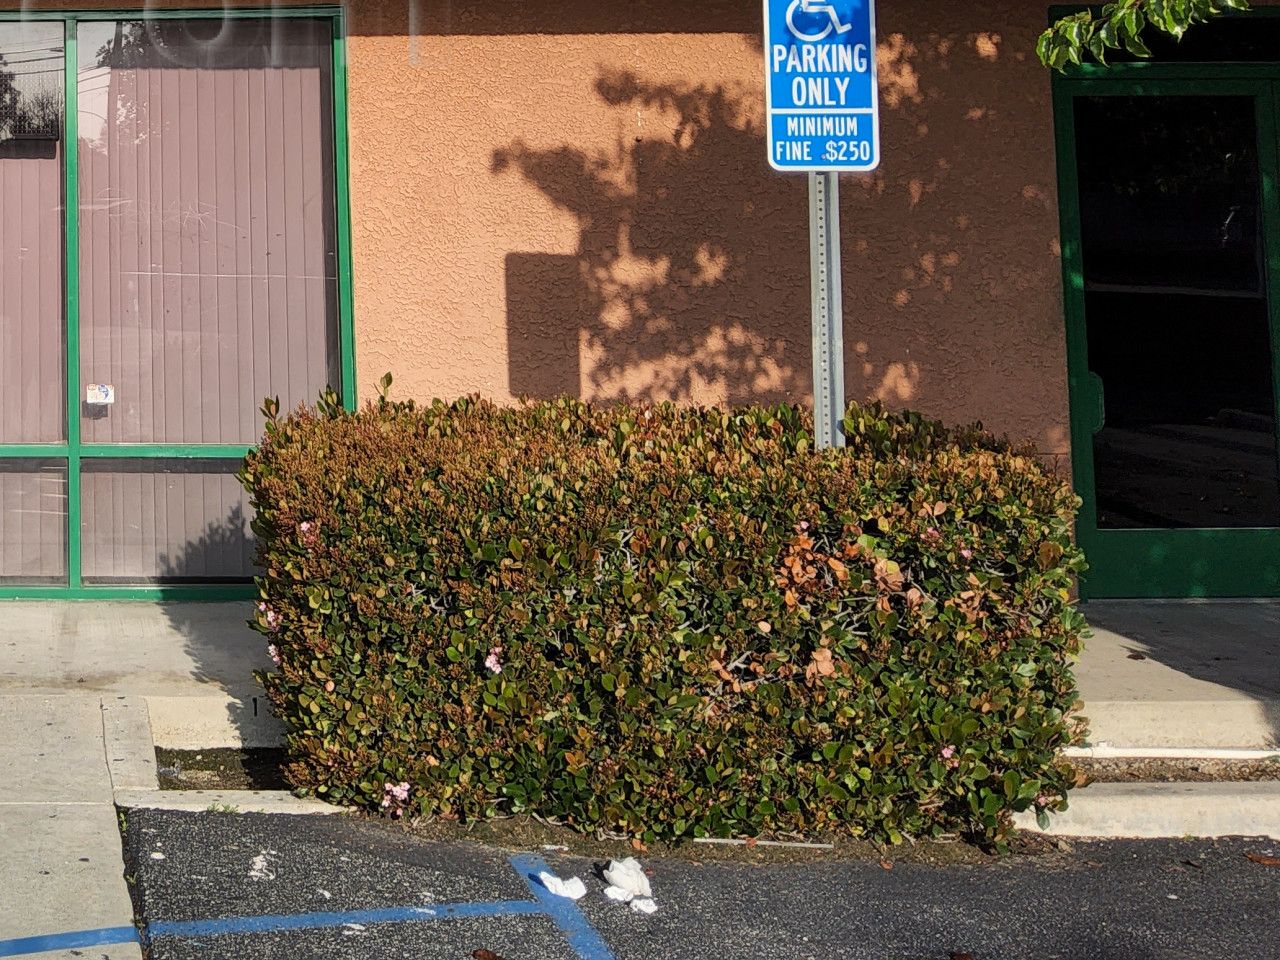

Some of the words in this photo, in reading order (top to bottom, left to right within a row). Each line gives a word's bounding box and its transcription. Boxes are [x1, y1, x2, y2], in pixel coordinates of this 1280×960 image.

[773, 44, 867, 73] PARKING
[792, 77, 850, 106] ONLY
[787, 117, 858, 137] MINIMUM
[776, 141, 812, 161] FINE
[825, 140, 870, 162] $250
